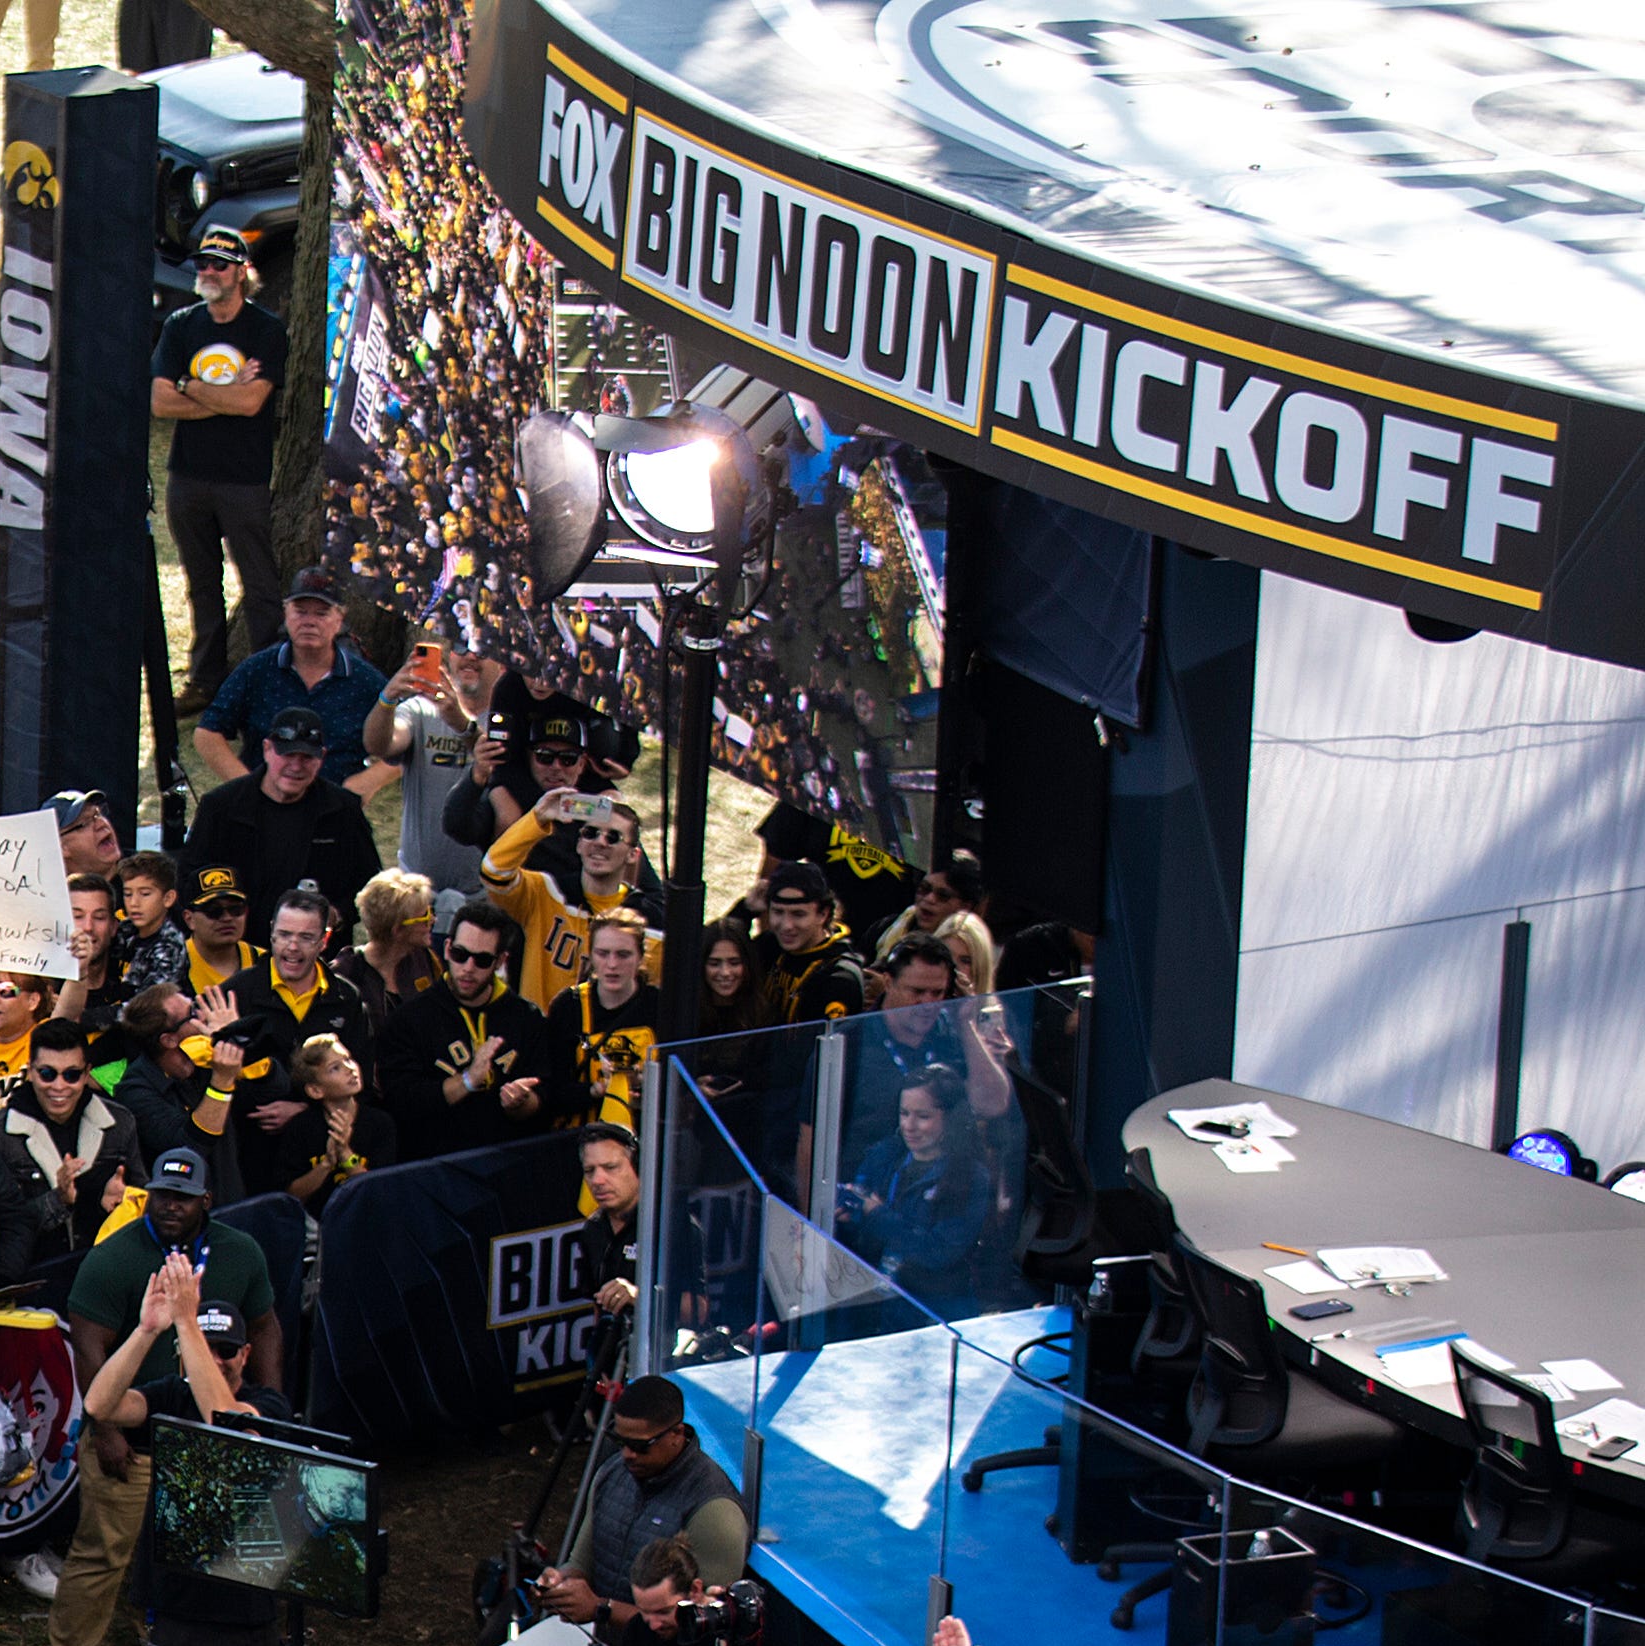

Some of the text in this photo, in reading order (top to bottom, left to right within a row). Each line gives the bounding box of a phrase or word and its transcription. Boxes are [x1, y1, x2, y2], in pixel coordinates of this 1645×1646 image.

[538, 73, 1556, 566] FOX BIG NOON KICKOFF
[435, 1042, 517, 1076] IOA
